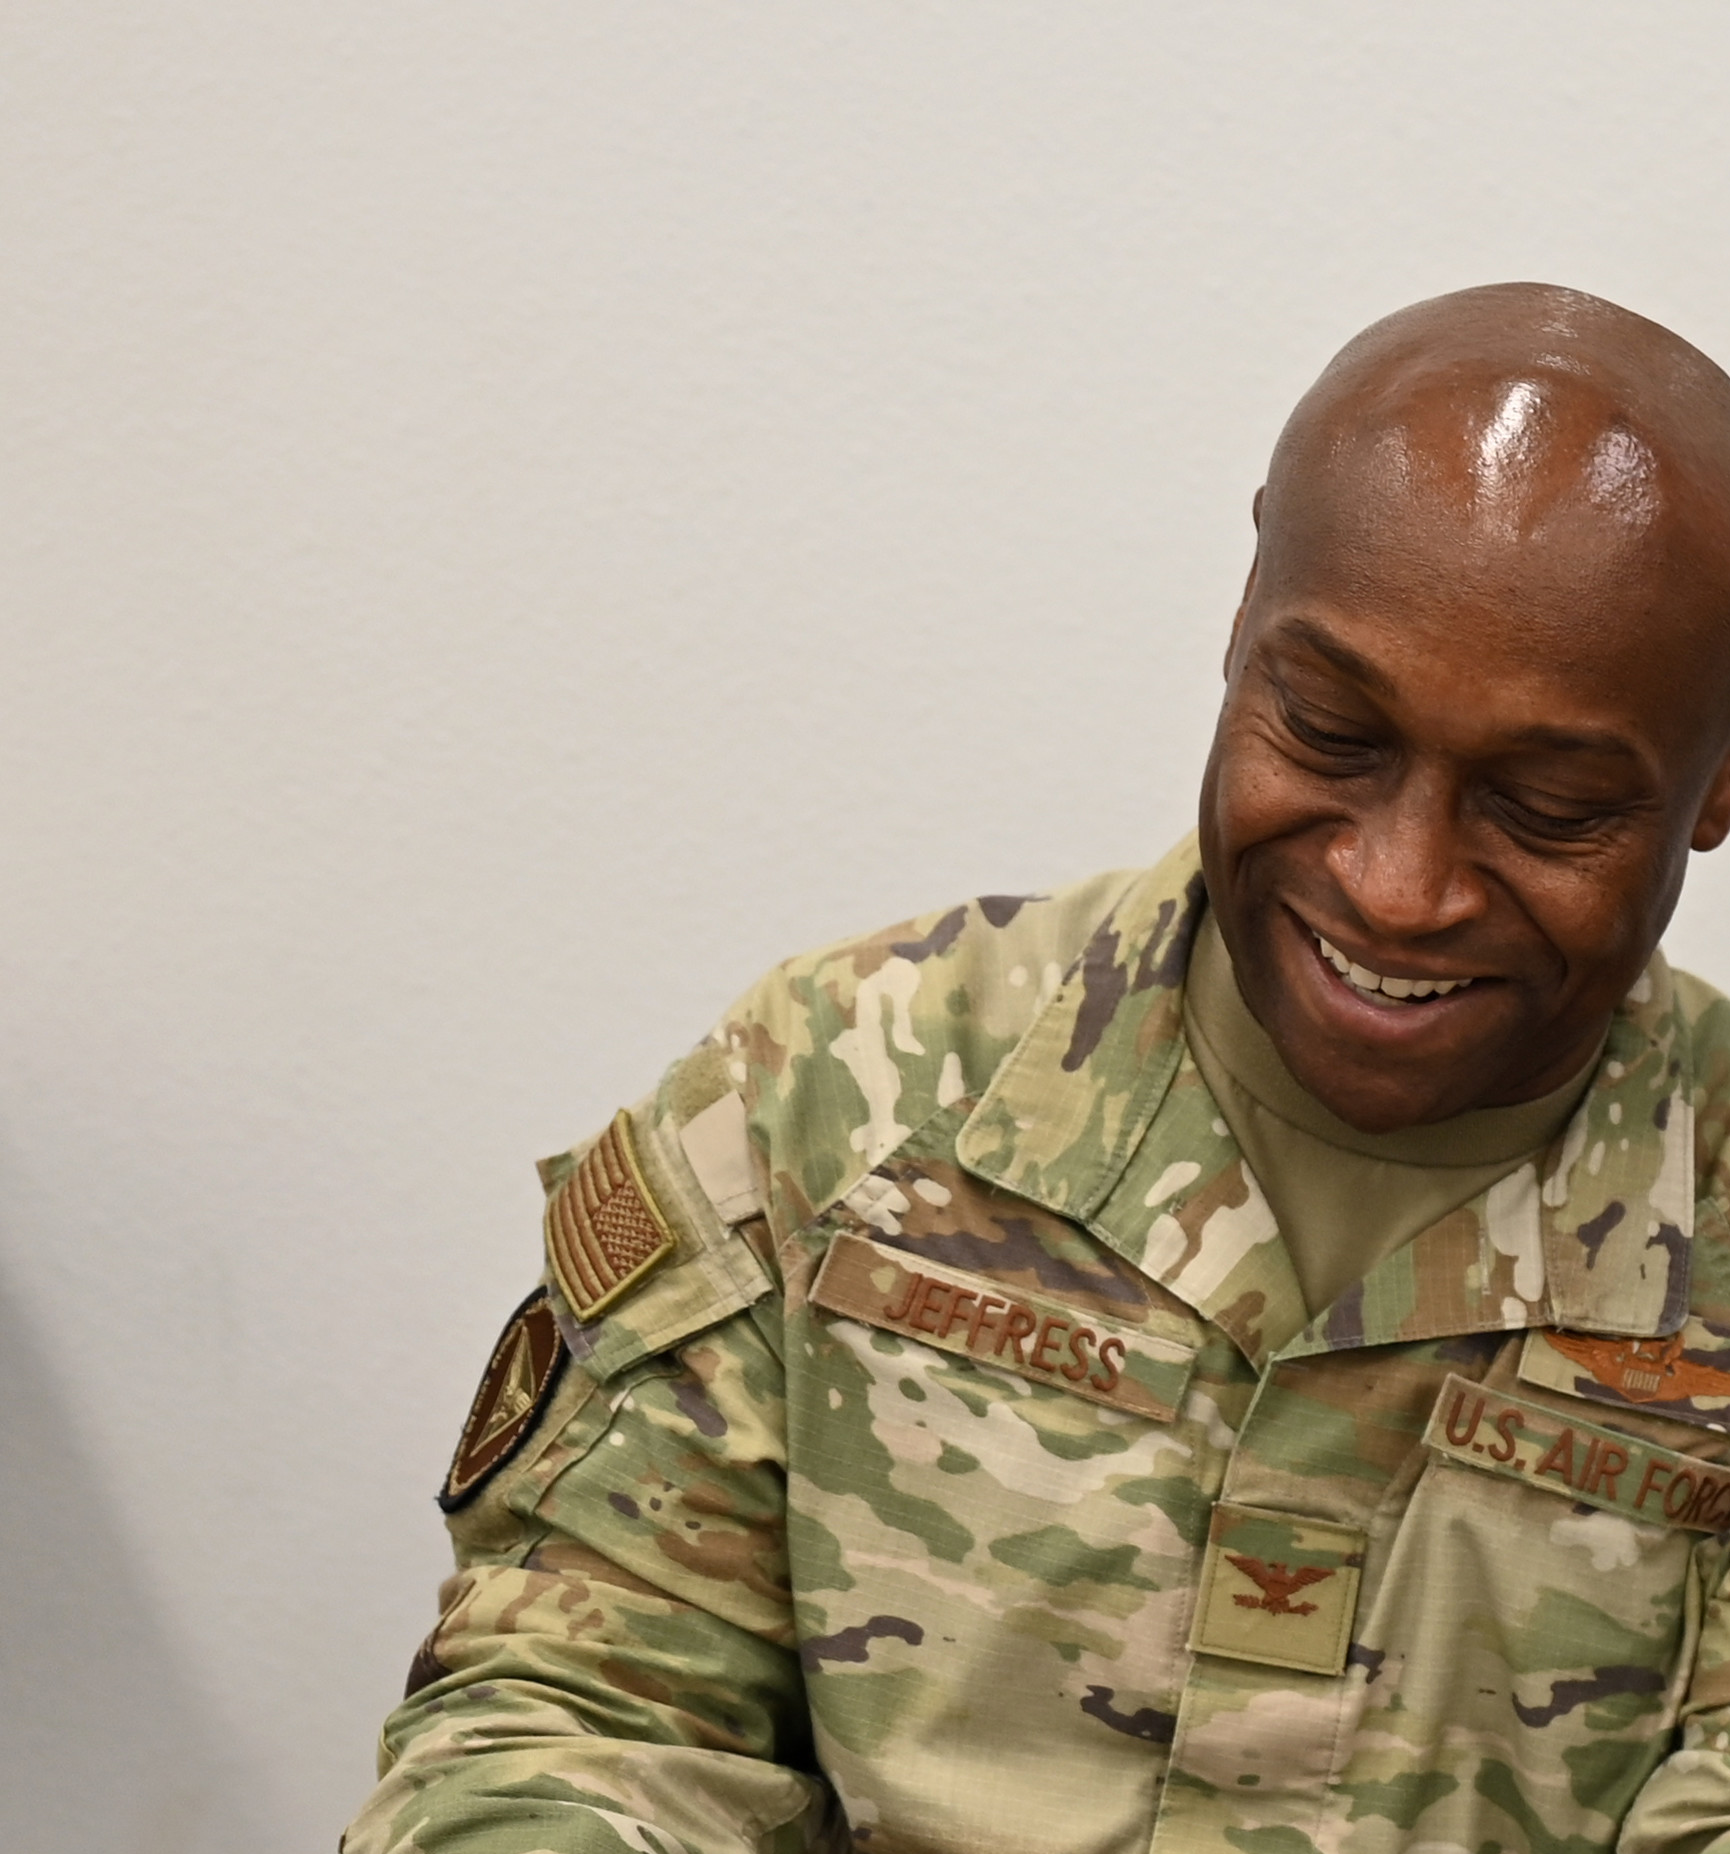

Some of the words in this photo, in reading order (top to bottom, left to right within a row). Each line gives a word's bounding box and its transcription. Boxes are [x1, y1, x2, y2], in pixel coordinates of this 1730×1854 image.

[883, 1272, 1126, 1393] JEFFRESS
[1445, 1391, 1527, 1471] U.S.
[1533, 1428, 1629, 1503] AIR
